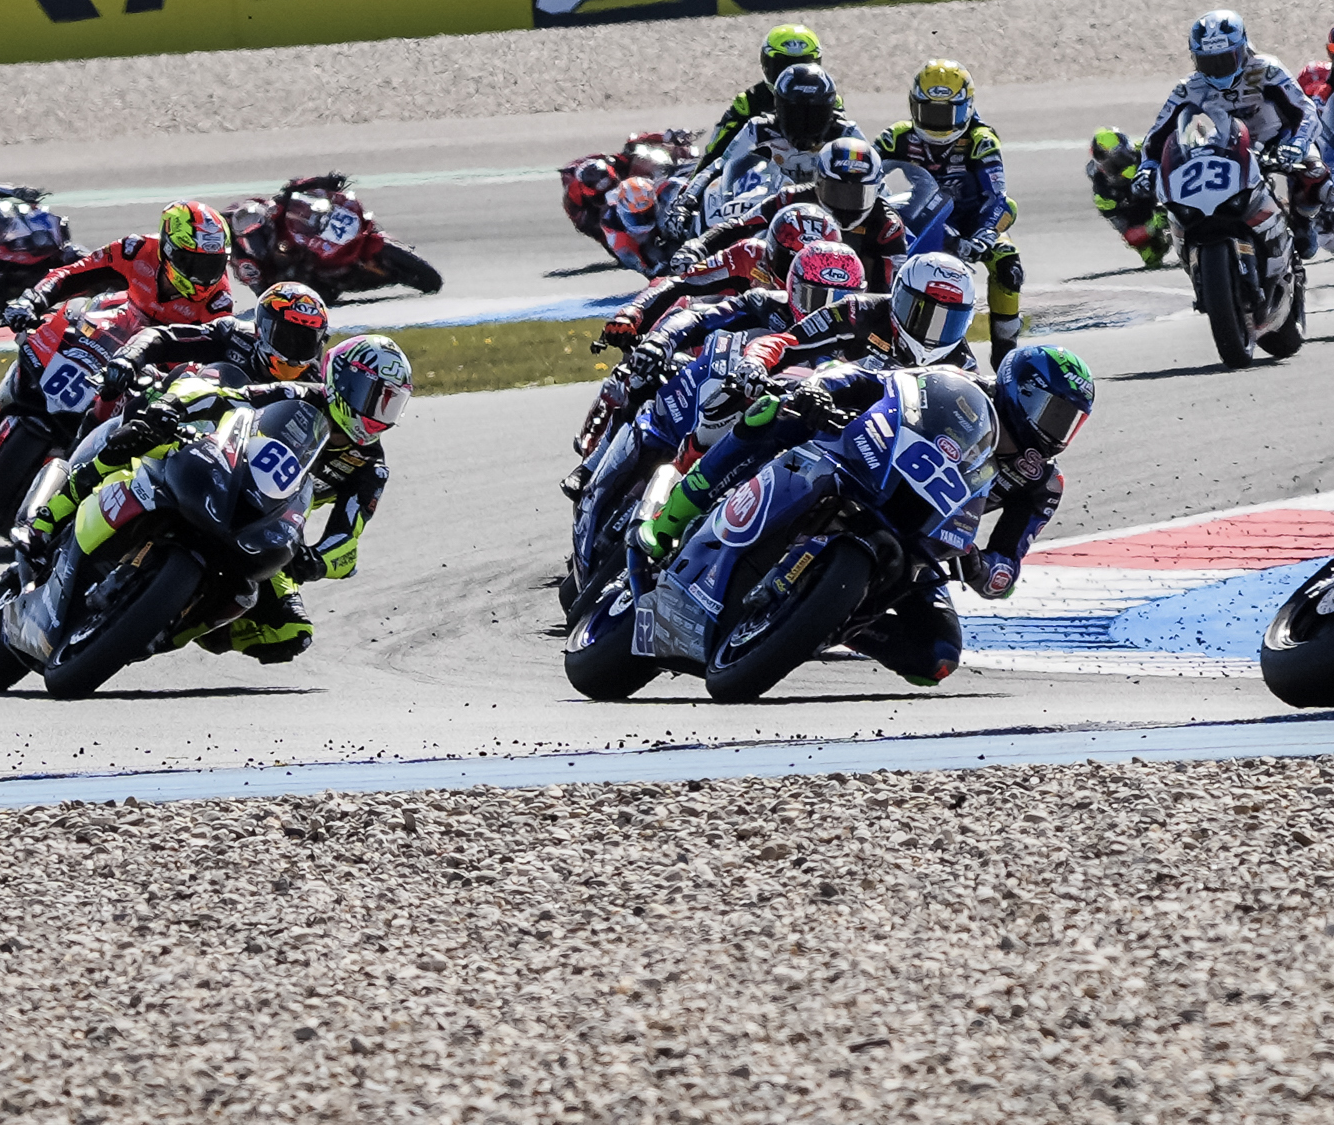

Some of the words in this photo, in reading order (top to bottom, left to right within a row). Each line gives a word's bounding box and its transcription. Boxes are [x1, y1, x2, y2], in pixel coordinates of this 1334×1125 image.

[1180, 160, 1232, 198] 23
[330, 209, 357, 241] 45
[42, 363, 95, 408] 65
[664, 394, 684, 424] YAMAHA
[250, 440, 302, 492] 69
[853, 433, 881, 470] YAMAHA
[133, 482, 151, 502] 765
[895, 440, 967, 515] 62
[729, 482, 757, 523] PATA
